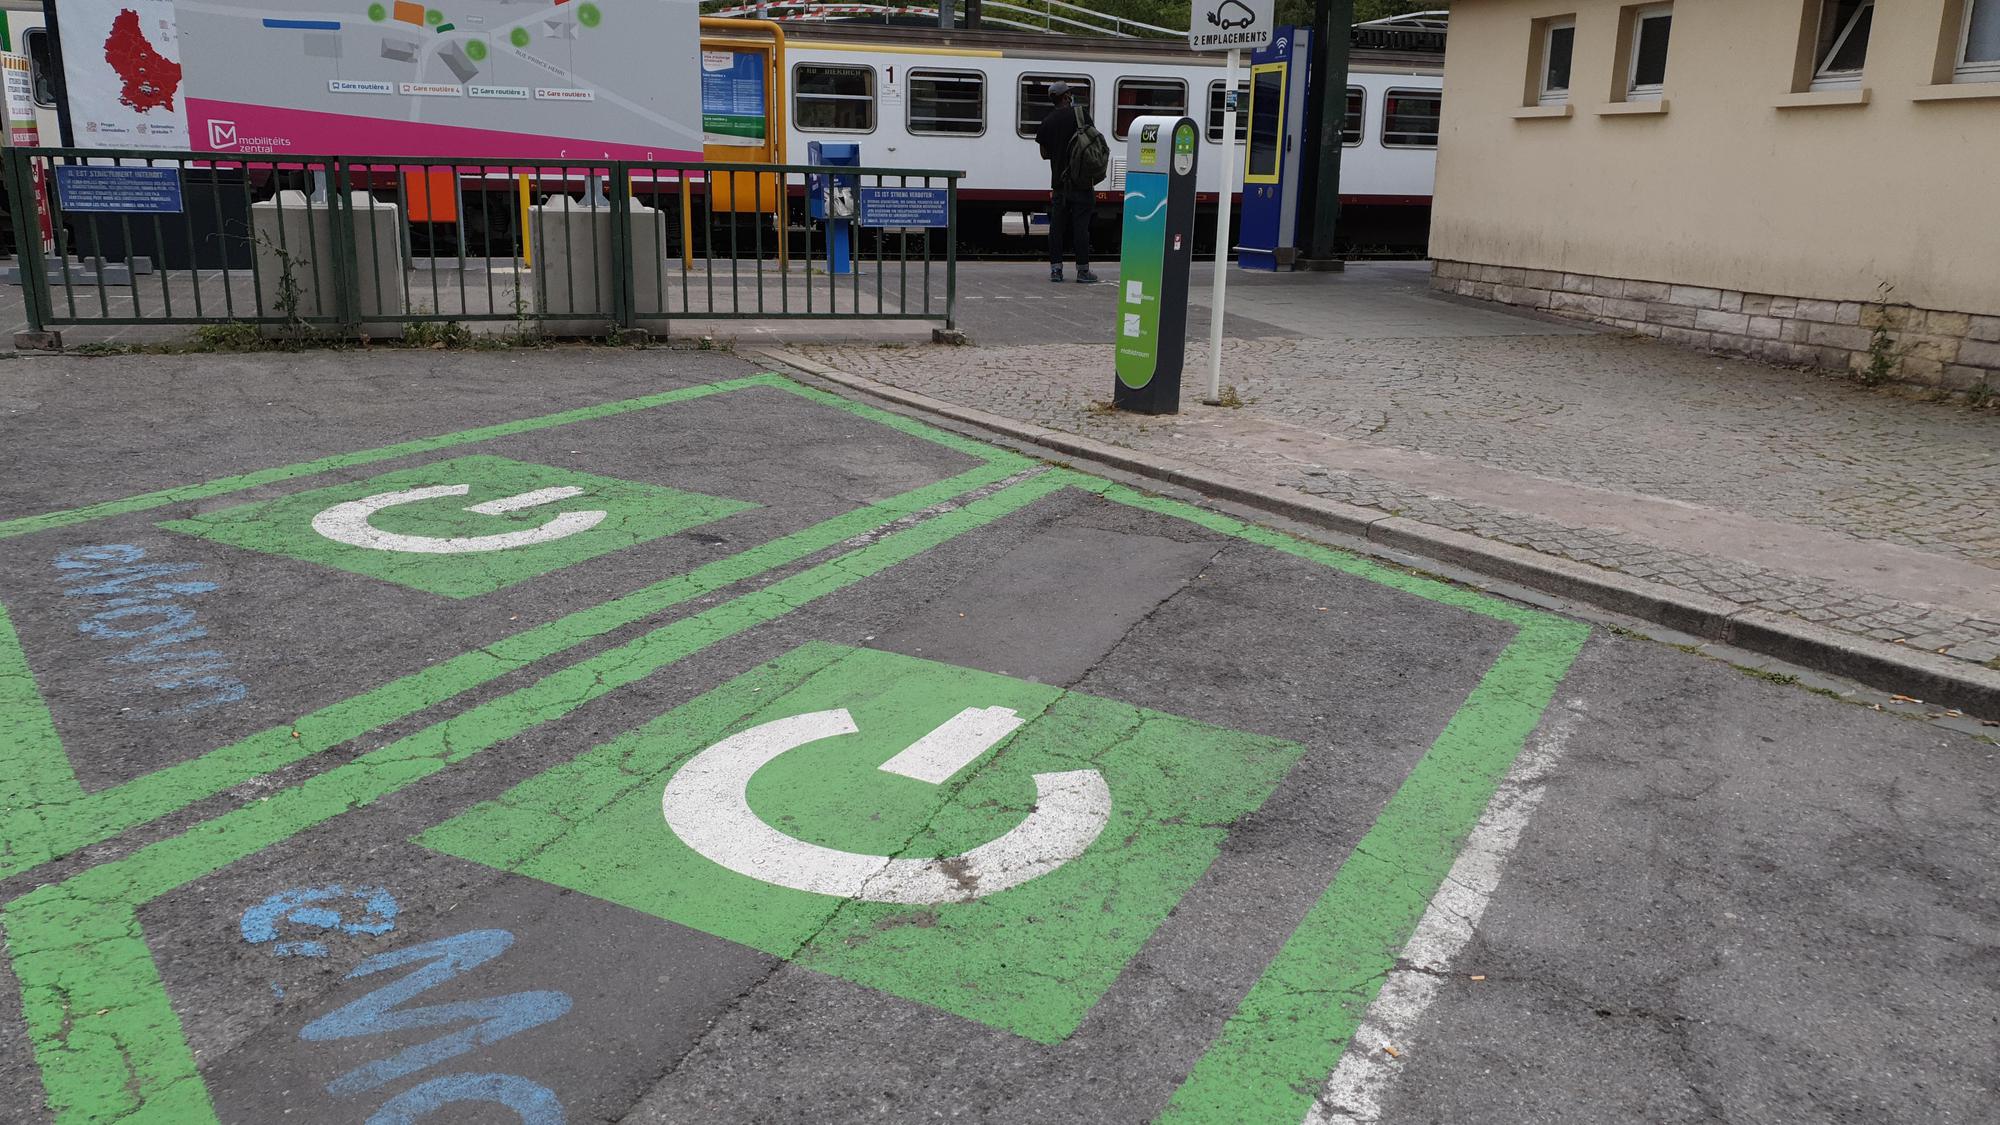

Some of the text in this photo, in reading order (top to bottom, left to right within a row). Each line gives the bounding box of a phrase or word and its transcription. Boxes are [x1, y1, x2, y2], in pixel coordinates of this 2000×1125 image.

[1193, 31, 1267, 46] 2 EMPLACEMENTS
[885, 66, 893, 83] 1
[341, 82, 356, 90] Gare
[357, 83, 384, 91] routière
[413, 84, 428, 92] Gare
[428, 85, 455, 93] routière
[495, 88, 521, 96] routière
[238, 136, 291, 146] mobilitéits
[239, 145, 274, 153] zentral
